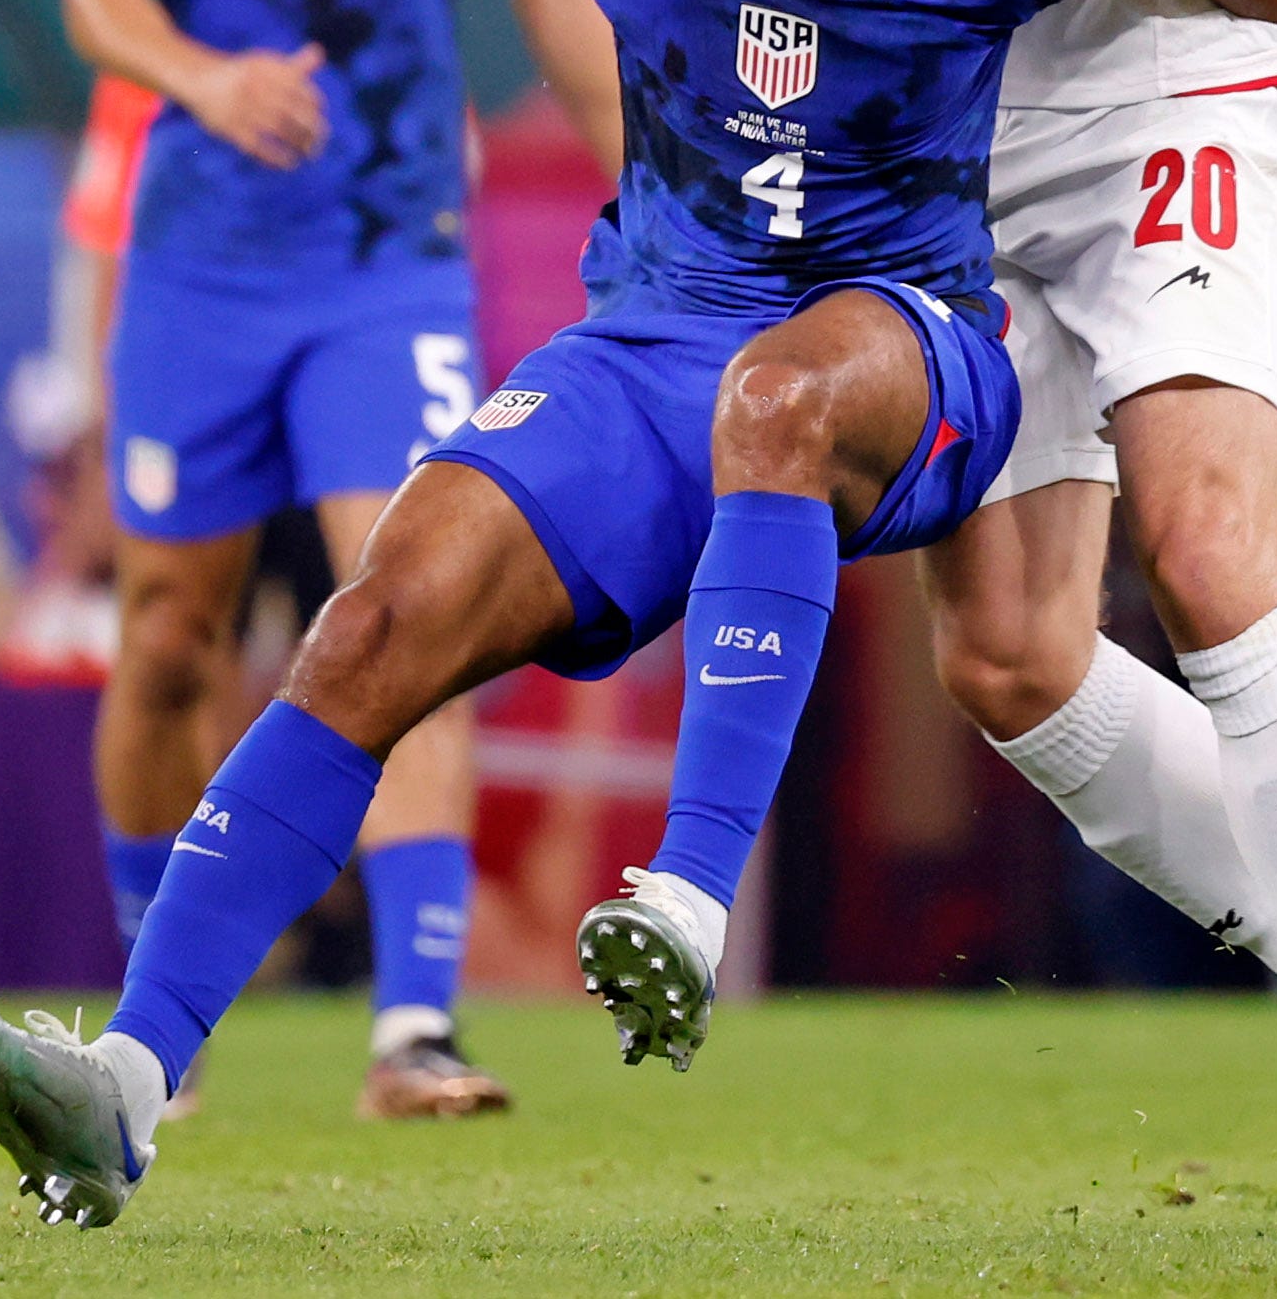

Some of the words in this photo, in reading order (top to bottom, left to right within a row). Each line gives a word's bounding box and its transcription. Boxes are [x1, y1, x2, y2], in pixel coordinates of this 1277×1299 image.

[745, 9, 813, 52] USA
[724, 117, 740, 133] 29
[737, 109, 764, 126] IRAN
[785, 121, 807, 137] USA
[741, 151, 805, 239] 4
[1134, 145, 1238, 250] 20
[411, 332, 474, 440] 5
[493, 392, 541, 408] USA
[713, 625, 782, 657] USA
